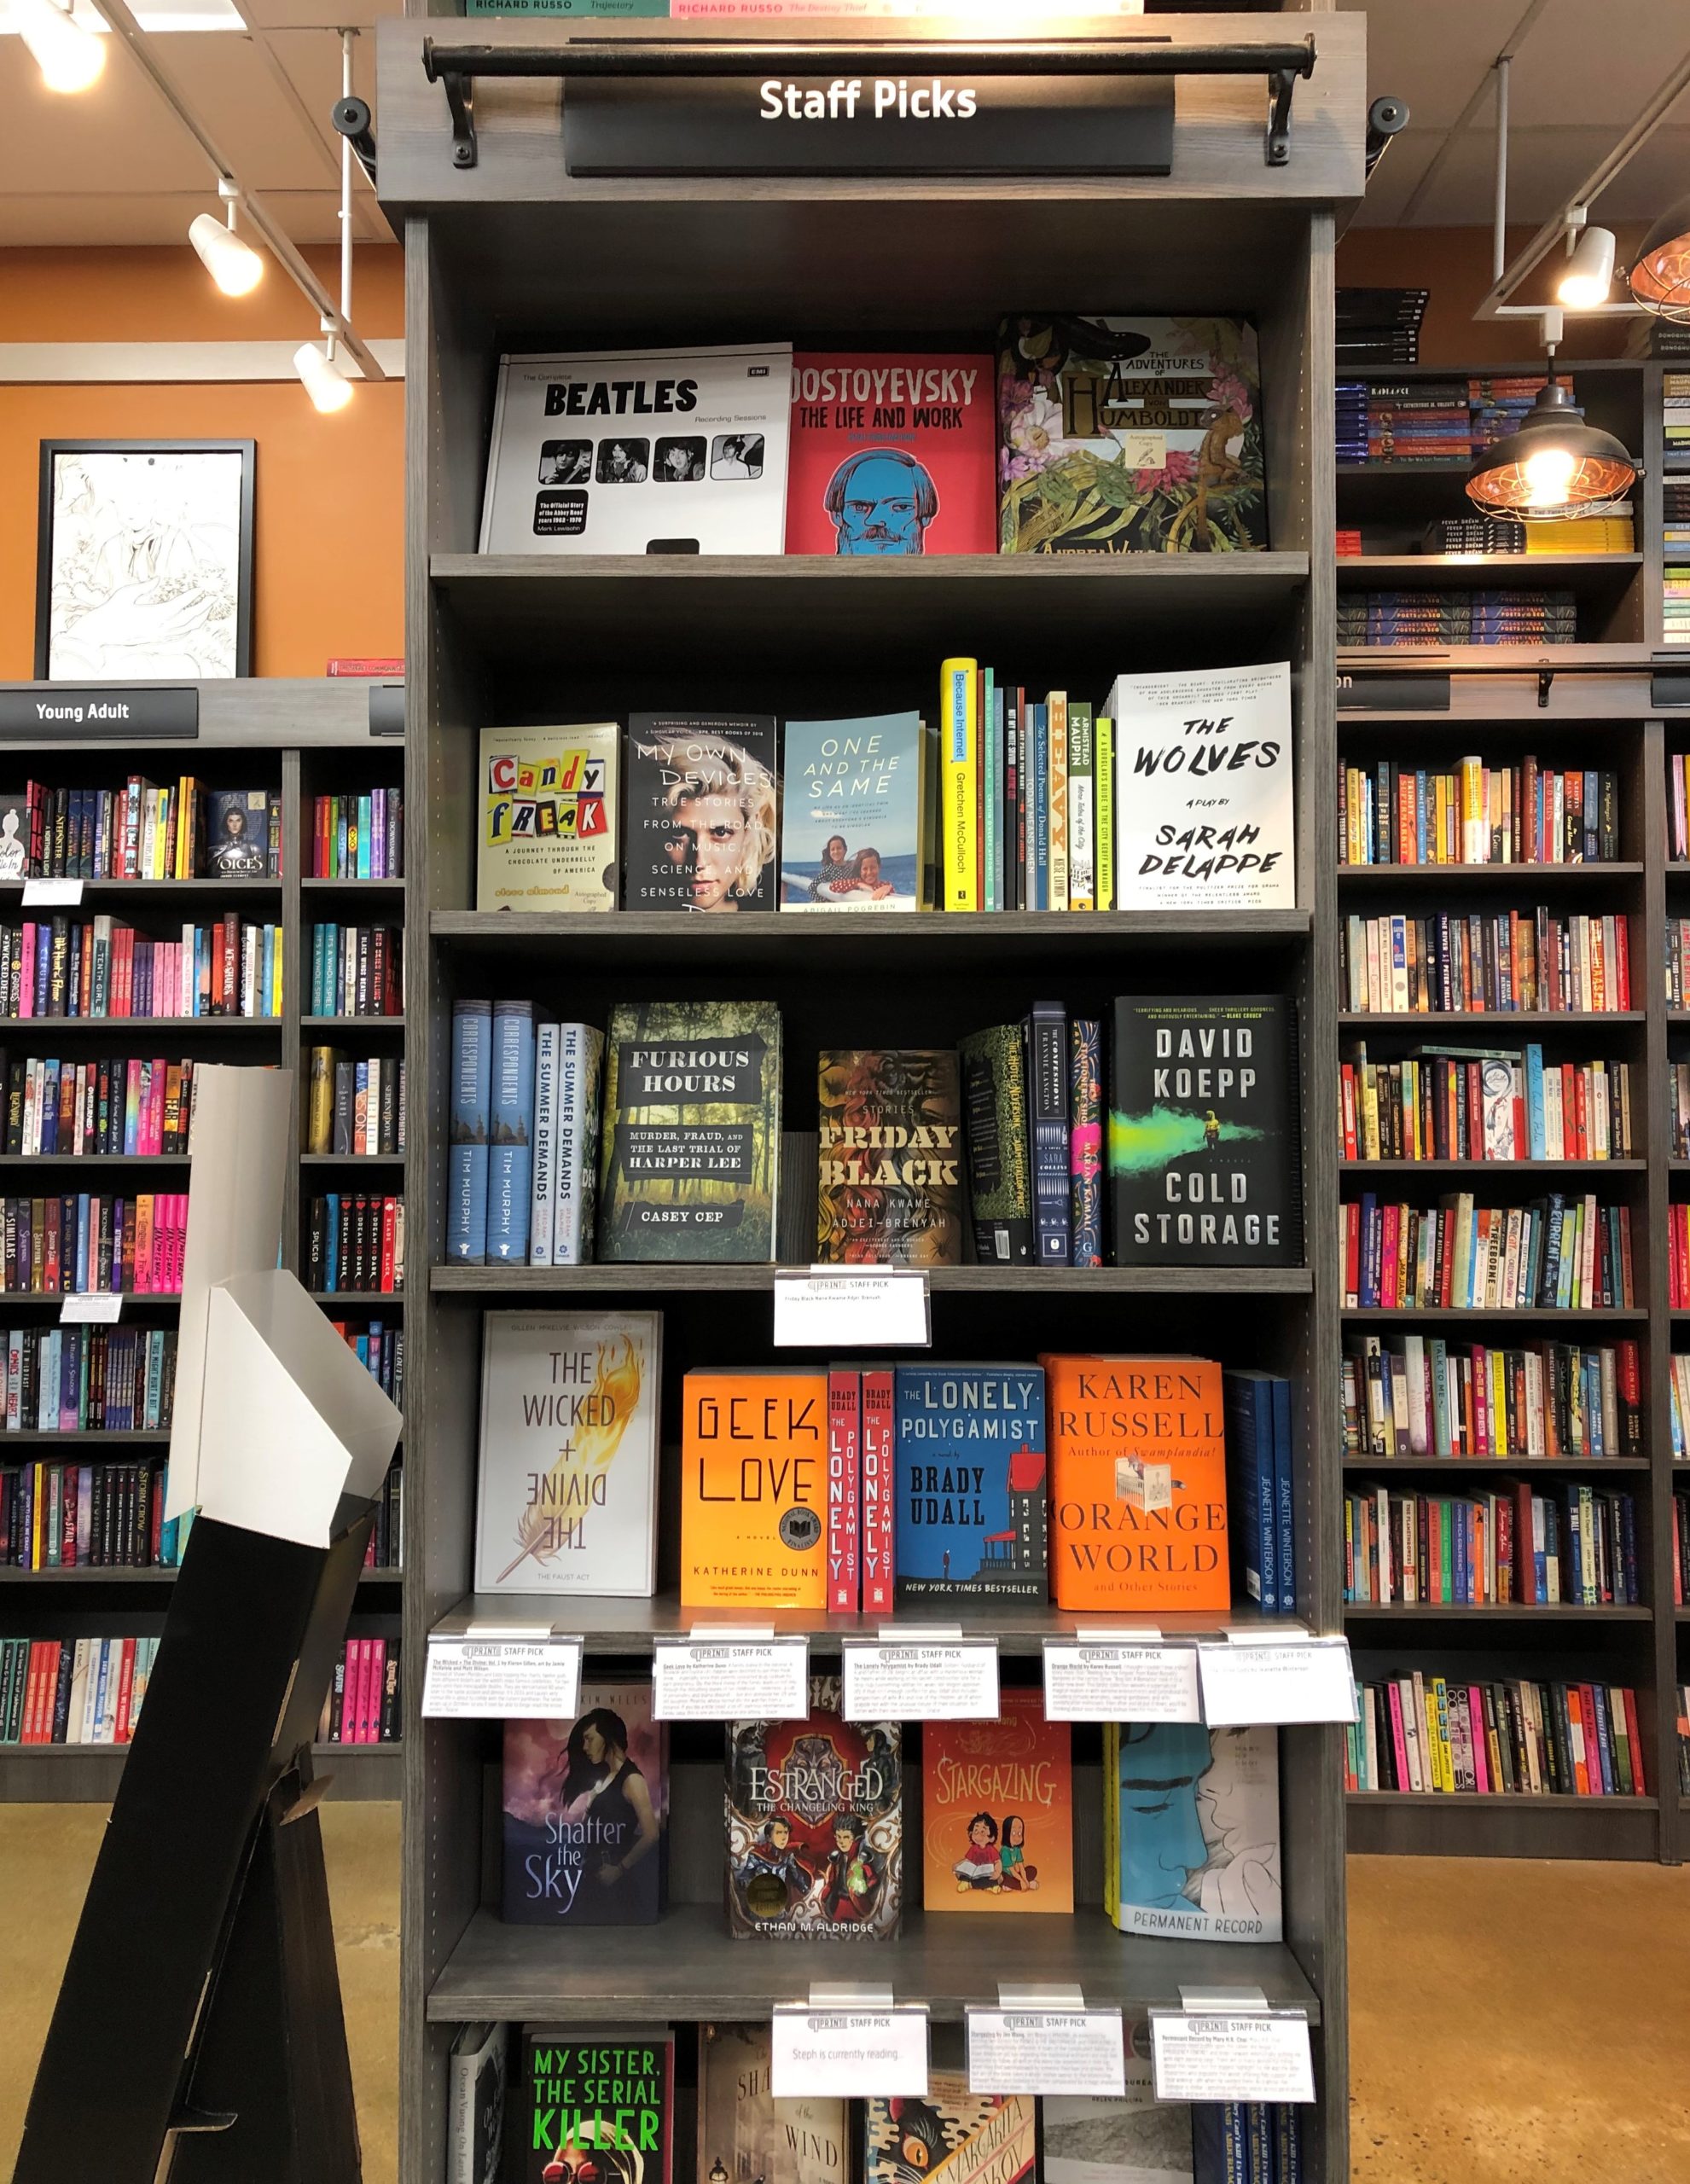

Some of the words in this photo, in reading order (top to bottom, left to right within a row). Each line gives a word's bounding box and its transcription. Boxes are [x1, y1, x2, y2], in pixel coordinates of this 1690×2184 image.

[476, 0, 531, 9] RICHARD
[533, 0, 572, 9] RUSSO
[591, 1, 633, 11] Trajectory
[760, 80, 862, 119] Staff
[874, 80, 977, 119] Picks
[1126, 359, 1204, 369] ADVENTURES
[544, 380, 698, 415] BEATLES
[1099, 362, 1217, 406] ALEXANDER
[800, 407, 828, 428] THE
[834, 407, 863, 429] LIFE
[873, 406, 905, 428] AND
[912, 406, 963, 429] WORK
[1067, 377, 1203, 434] HUMBOLDT
[955, 673, 964, 717] Because
[36, 704, 82, 722] Young
[88, 703, 129, 718] Adult
[1183, 717, 1234, 735] THE
[822, 735, 883, 756] ONE
[955, 718, 964, 758] Internet
[1071, 717, 1081, 766] MAUPIN
[636, 745, 673, 765] MY
[686, 745, 746, 763] OWN
[804, 762, 849, 776] AND
[860, 757, 900, 772] THE
[1134, 741, 1280, 776] WOLVES
[493, 756, 600, 790] Candy
[660, 770, 771, 787] DEVICES
[809, 776, 891, 797] SAME
[1053, 700, 1066, 851] HEAVY
[653, 798, 687, 806] TRUE
[695, 798, 754, 807] STORIES
[955, 772, 966, 817] Gretchen
[1187, 799, 1193, 808] A
[644, 820, 682, 828] FROM
[724, 821, 763, 830] ROAD
[1156, 824, 1260, 852] SARAH
[665, 843, 683, 851] ON
[725, 865, 753, 874] AND
[1138, 852, 1282, 881] DELAPPE
[641, 888, 719, 897] SENSELESS
[728, 888, 764, 897] LOVE
[96, 952, 104, 981] TENTH
[566, 1030, 576, 1057] THE
[1156, 1029, 1252, 1059] DAVID
[461, 1018, 479, 1104] CORRESPONDENTS
[630, 1050, 748, 1068] FURIOUS
[564, 1061, 575, 1123] SUMMER
[642, 1075, 735, 1093] HOURS
[1154, 1069, 1256, 1098] KOEPP
[862, 1106, 915, 1114] STORIES
[630, 1132, 679, 1141] MURDER,
[683, 1132, 724, 1141] FRAUD,
[820, 1126, 957, 1148] FRIDAY
[560, 1129, 572, 1200] DEMANDS
[630, 1158, 701, 1169] HARPER
[708, 1158, 740, 1168] LEE
[820, 1160, 958, 1185] BLACK
[1166, 1172, 1246, 1203] COLD
[462, 1178, 470, 1234] MURPHY
[846, 1199, 880, 1208] NANA
[890, 1199, 931, 1208] KWAME
[642, 1212, 688, 1223] CASEY
[692, 1212, 723, 1222] CEP
[833, 1218, 946, 1228] ADJEI-BRENYAH
[1134, 1213, 1280, 1245] STORAGE
[6, 1219, 15, 1258] SIMILARS
[1548, 1211, 1562, 1262] CURRENT
[1488, 1226, 1499, 1284] TREEBORNE
[549, 1352, 592, 1384] THE
[1438, 1368, 1443, 1381] TO
[904, 1390, 920, 1400] THE
[925, 1381, 1032, 1410] LONELY
[1077, 1374, 1202, 1400] KAREN
[1438, 1384, 1444, 1397] ME
[523, 1395, 615, 1426] WICKED
[699, 1397, 818, 1440] GEEK
[902, 1419, 1038, 1439] POLYGAMIST
[1059, 1412, 1223, 1438] RUSSELL
[526, 1473, 606, 1506] DIVINE
[700, 1458, 816, 1505] LOVE
[910, 1467, 984, 1493] BRADY
[910, 1498, 984, 1525] UDALL
[1262, 1476, 1271, 1524] JEANETTE
[1060, 1503, 1225, 1531] ORANGE
[543, 1517, 586, 1549] THE
[1069, 1544, 1217, 1572] WORLD
[1263, 1526, 1274, 1584] WINTERSON
[694, 1566, 772, 1576] KATHERINE
[781, 1567, 819, 1577] DUNN
[928, 1583, 953, 1592] YORK
[955, 1583, 982, 1593] TIMES
[984, 1583, 1038, 1594] BESTSELLER
[1119, 1582, 1151, 1592] Other
[1158, 1582, 1197, 1591] Stories
[750, 1767, 882, 1803] ESTRANGED
[938, 1757, 1056, 1807] STARGAZING
[757, 1803, 775, 1812] THE
[781, 1803, 845, 1812] CHANGELING
[850, 1803, 874, 1813] KING
[545, 1813, 626, 1844] Shatter
[557, 1845, 581, 1866] the
[526, 1855, 582, 1914] Sky
[755, 1923, 796, 1932] ETHAN
[801, 1924, 814, 1932] M.
[816, 1923, 874, 1933] ALDRIDGE
[1134, 1912, 1209, 1931] PERMANENT
[1215, 1917, 1263, 1934] RECORD
[535, 2050, 569, 2075] MY
[578, 2050, 660, 2076] SISTER,
[793, 2049, 816, 2061] Steph
[819, 2049, 825, 2059] is
[828, 2049, 865, 2061] currently
[534, 2079, 575, 2104] THE
[584, 2080, 659, 2106] SERIAL
[533, 2109, 658, 2151] KILLER
[785, 2125, 839, 2169] WIND
